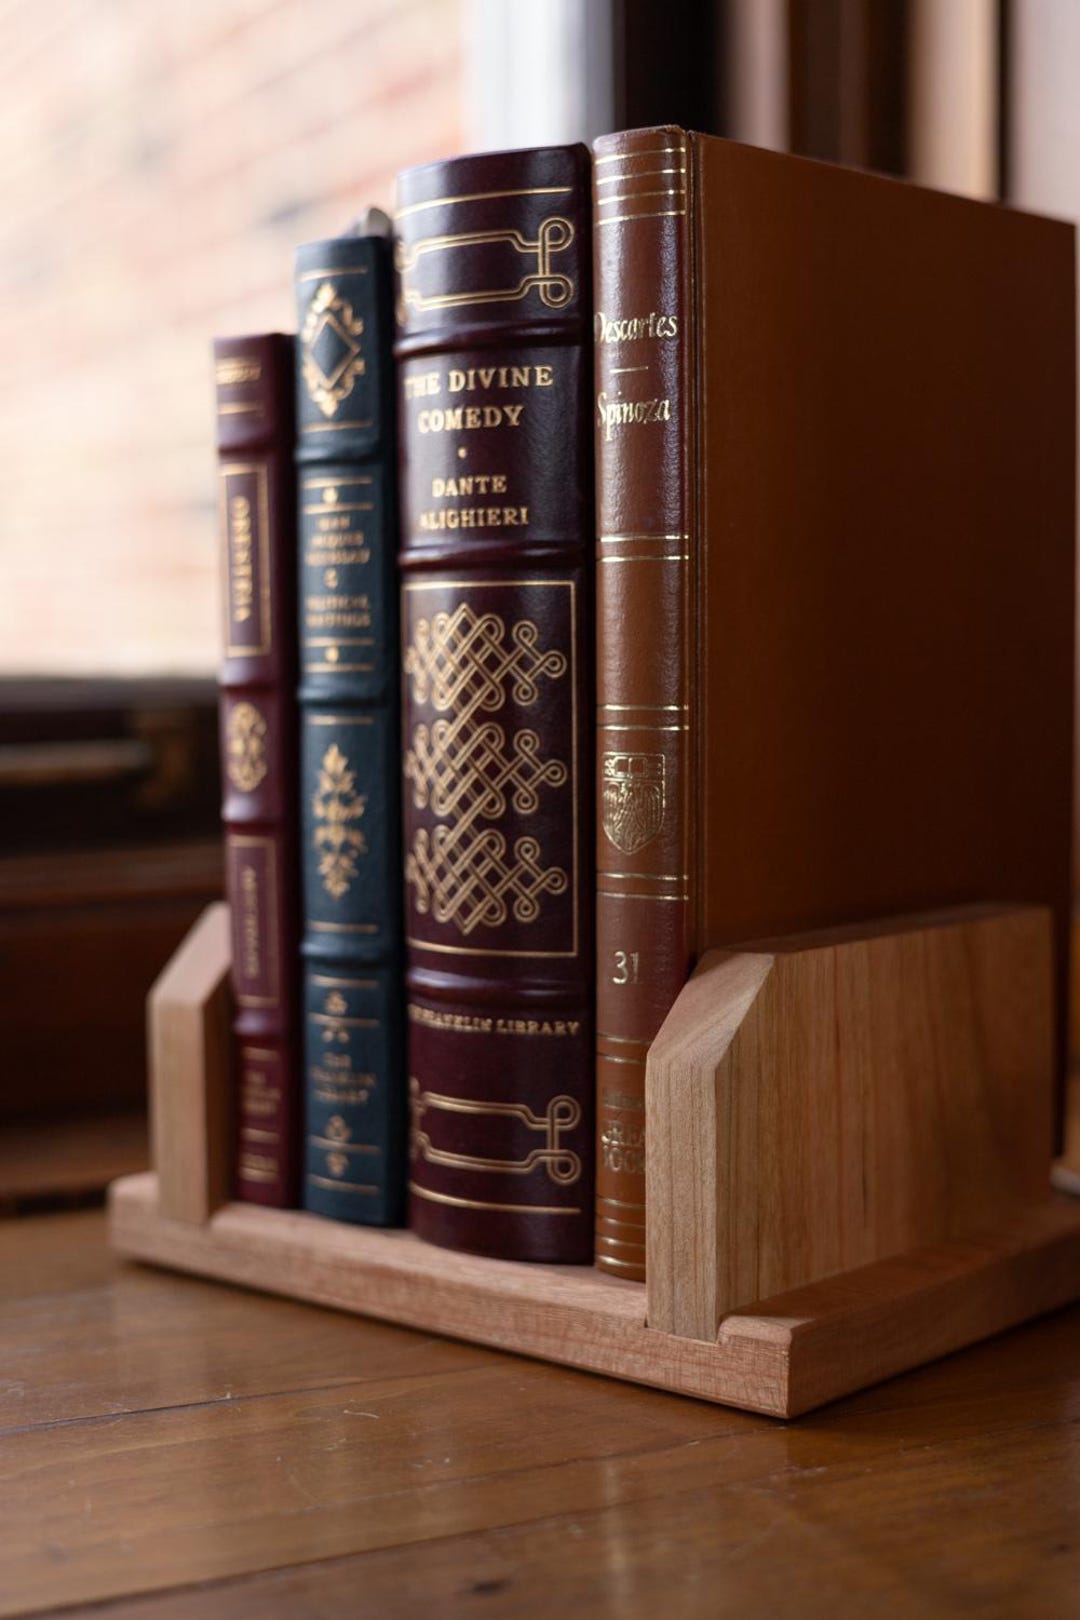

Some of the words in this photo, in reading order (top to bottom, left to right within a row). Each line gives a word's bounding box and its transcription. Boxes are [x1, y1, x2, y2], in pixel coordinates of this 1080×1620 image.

[404, 373, 440, 397] THE
[448, 365, 553, 392] DIVINE
[418, 405, 524, 433] COMEDY
[598, 392, 670, 441] Spinoza
[432, 476, 507, 497] DANTE
[420, 507, 529, 529] ALIGHIERI
[613, 951, 640, 984] 31
[497, 1018, 579, 1034] LIBRARY
